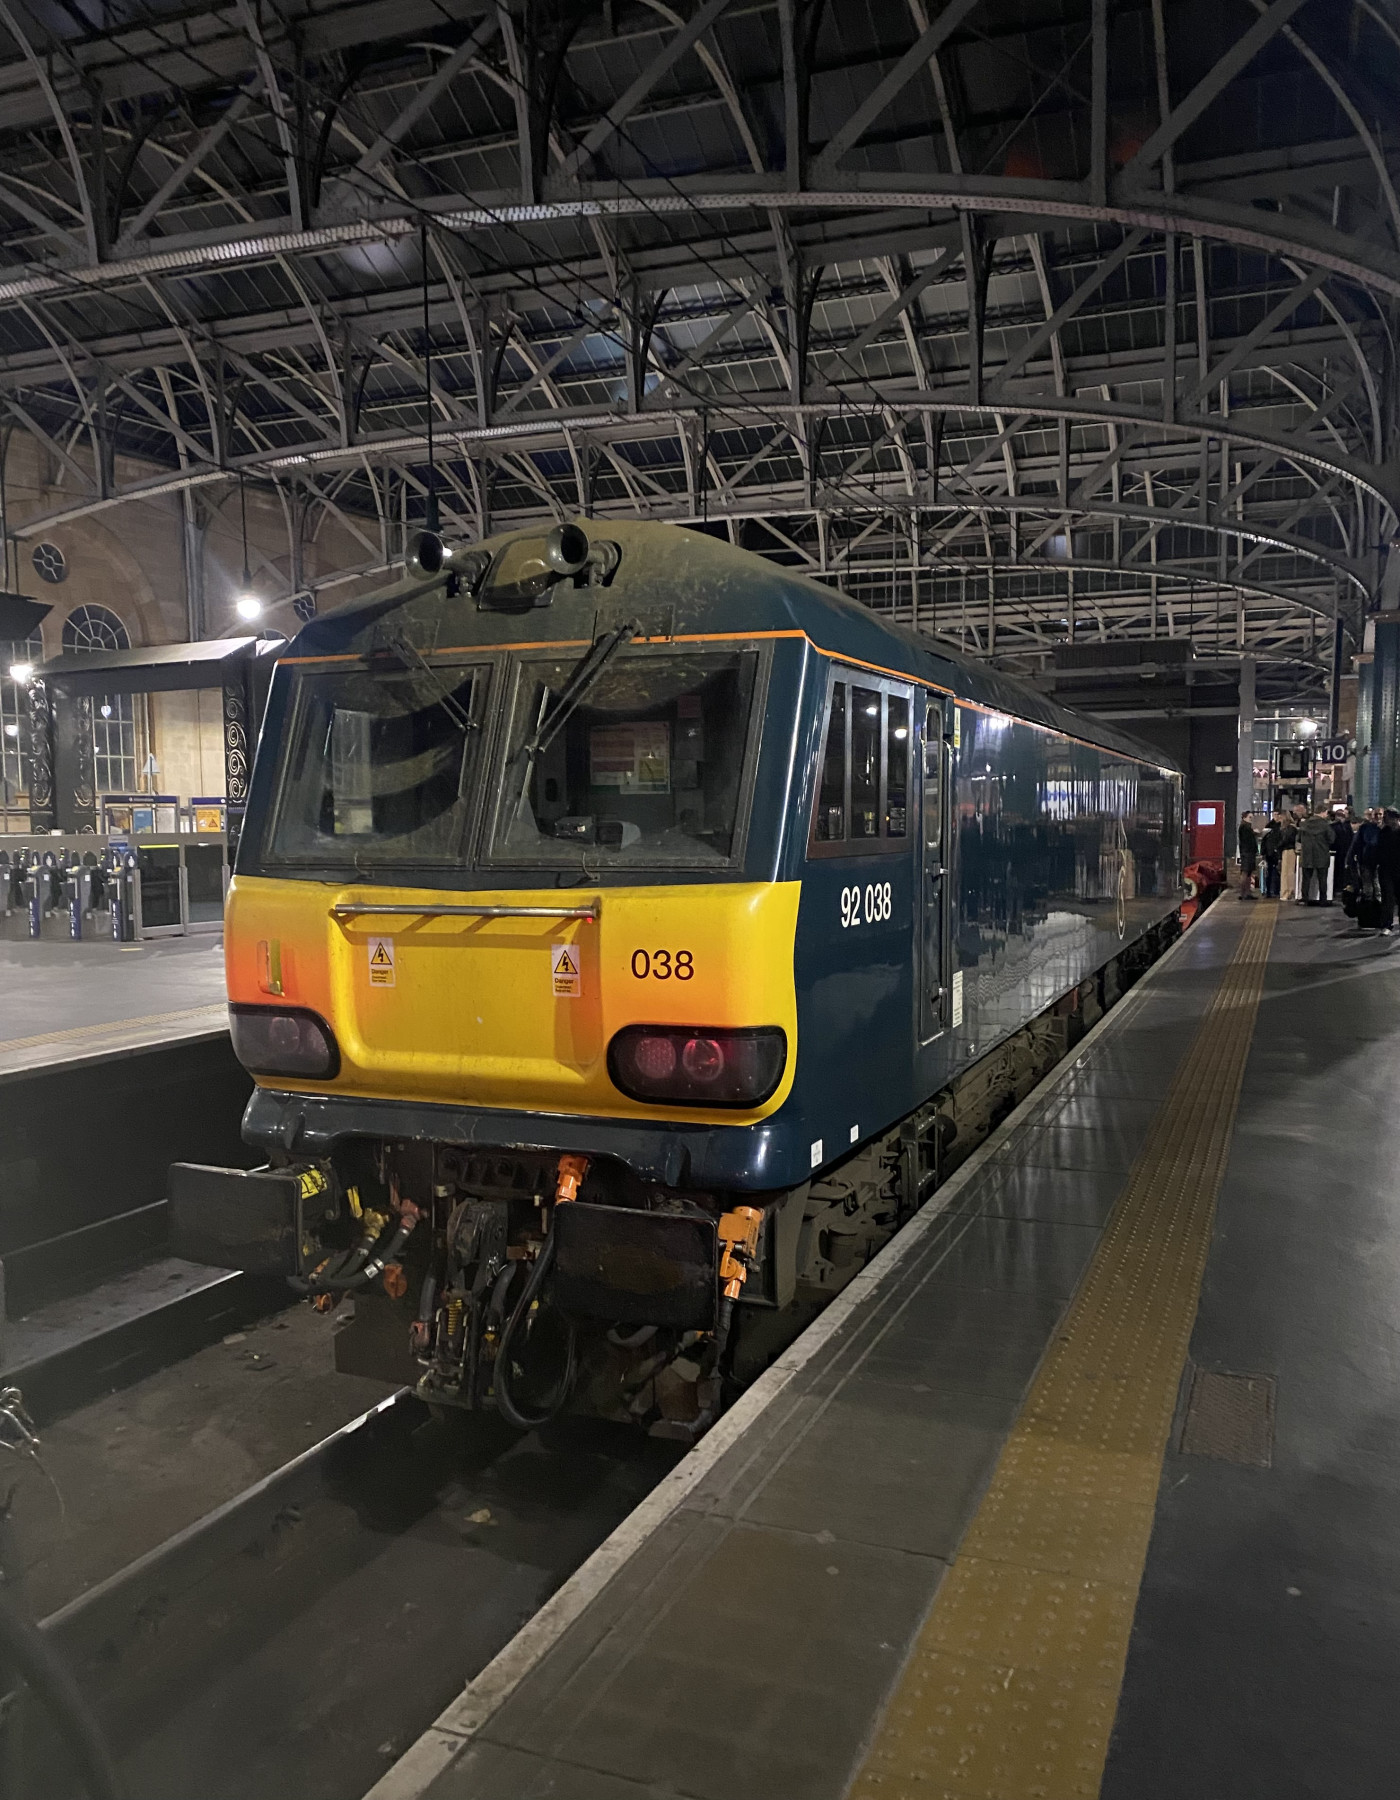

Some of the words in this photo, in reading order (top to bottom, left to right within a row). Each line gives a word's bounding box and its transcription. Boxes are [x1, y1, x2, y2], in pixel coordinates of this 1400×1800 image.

[1324, 744, 1345, 761] 10
[841, 885, 861, 928] 92
[865, 881, 892, 923] 038
[631, 949, 695, 980] 038
